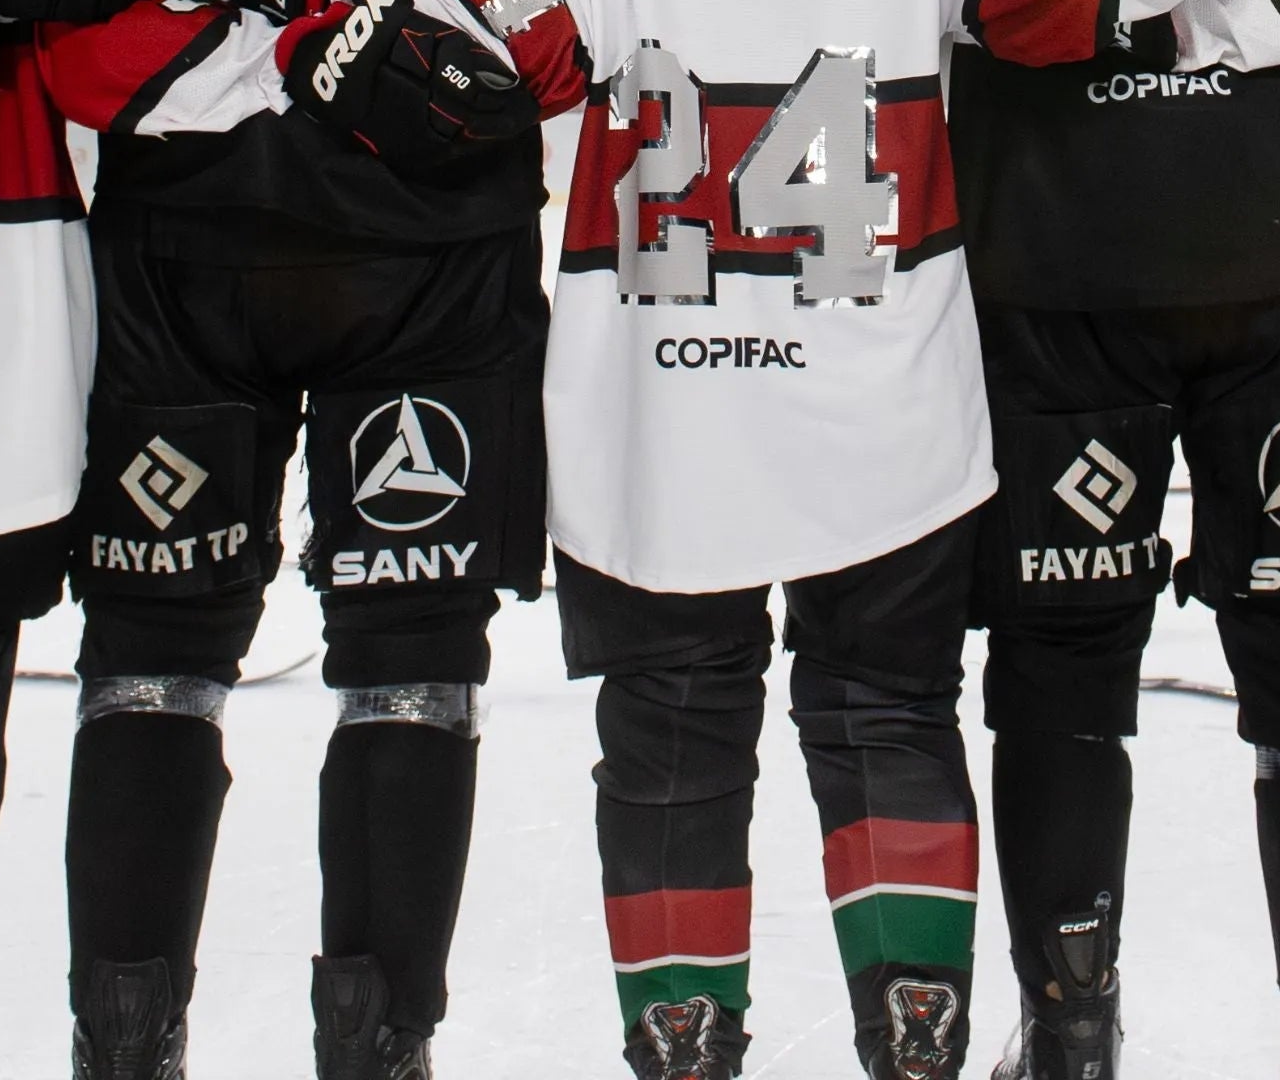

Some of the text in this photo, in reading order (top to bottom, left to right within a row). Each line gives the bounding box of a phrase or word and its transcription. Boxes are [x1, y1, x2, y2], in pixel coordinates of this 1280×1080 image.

[440, 63, 471, 91] 500
[1086, 69, 1232, 104] COPIFAC
[608, 38, 900, 310] 24
[654, 336, 807, 370] COPIFAC
[91, 522, 250, 574] FAYAT TP
[331, 541, 480, 587] SANY
[1020, 532, 1160, 582] FAYAT T
[1059, 919, 1100, 934] CCM
